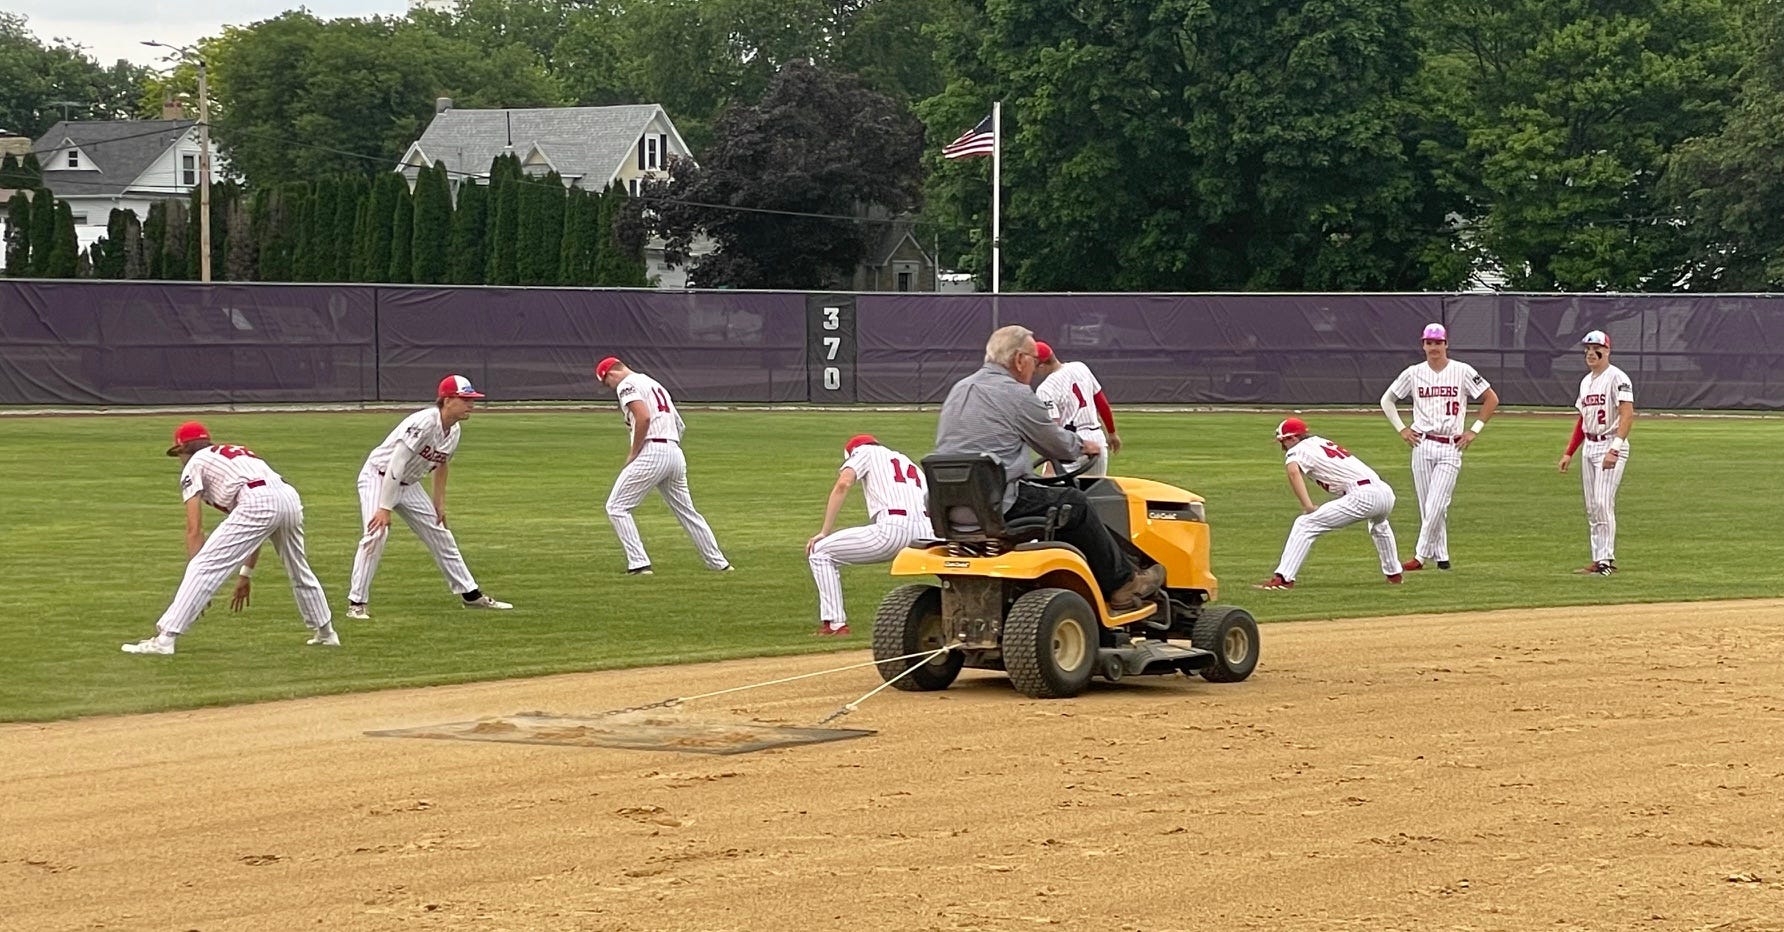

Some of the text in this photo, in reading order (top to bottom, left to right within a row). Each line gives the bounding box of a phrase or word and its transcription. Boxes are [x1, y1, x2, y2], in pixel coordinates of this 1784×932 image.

[823, 307, 841, 390] 370
[651, 386, 671, 413] 11
[1072, 382, 1087, 408] 1
[1417, 386, 1459, 398] RAIDERS
[1445, 401, 1460, 416] 16
[1597, 409, 1606, 424] 2
[890, 457, 923, 490] 14
